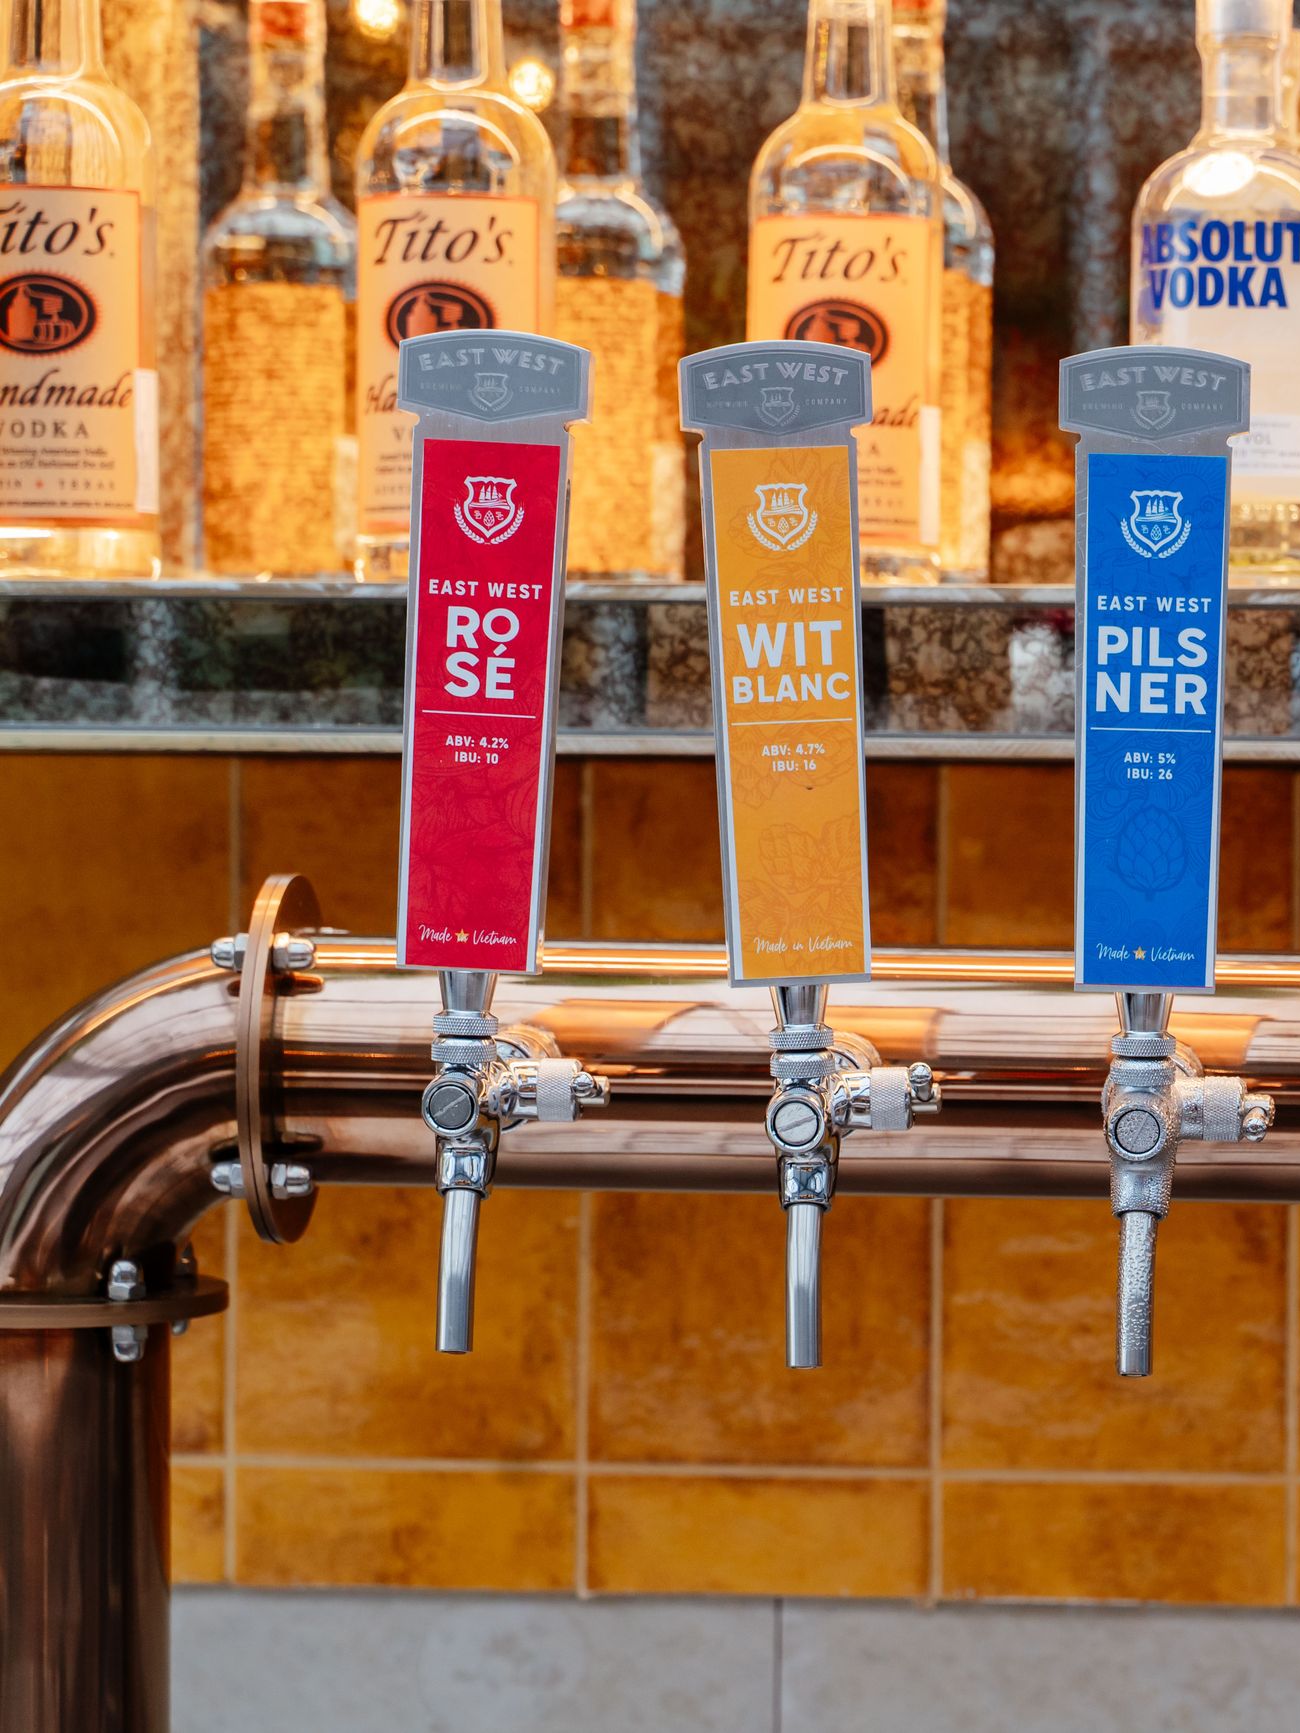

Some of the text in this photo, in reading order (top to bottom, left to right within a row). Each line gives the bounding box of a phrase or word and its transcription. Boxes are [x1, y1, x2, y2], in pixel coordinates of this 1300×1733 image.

[374, 211, 513, 265] Tito's
[773, 233, 909, 285] Tito's
[1149, 266, 1289, 310] VODKA
[418, 347, 565, 375] EAST WEST
[0, 368, 133, 408] ndmade
[703, 362, 849, 390] EAST WEST
[1080, 365, 1226, 392] EAST WEST
[429, 579, 543, 600] EAST WEST
[729, 587, 843, 607] EAST WEST
[1097, 595, 1212, 613] EAST WEST
[446, 606, 520, 649] RO
[736, 620, 842, 668] WIT
[1097, 625, 1208, 668] PILS
[444, 643, 515, 699] SÉ
[732, 672, 850, 704] BLANC
[1096, 671, 1208, 715] NER
[446, 735, 509, 749] ABV: 4.2%
[761, 743, 825, 757] ABV: 4.7%
[454, 751, 499, 764] IBU: 10
[772, 759, 817, 772] IBU: 16
[1124, 752, 1176, 764] ABV: 5%
[1127, 768, 1173, 780] IBU: 26
[418, 924, 452, 943] Made
[473, 930, 517, 945] Vietnam
[754, 936, 854, 954] Made in Vietnam
[1096, 942, 1130, 961] Made
[1151, 947, 1195, 962] Vietnam
